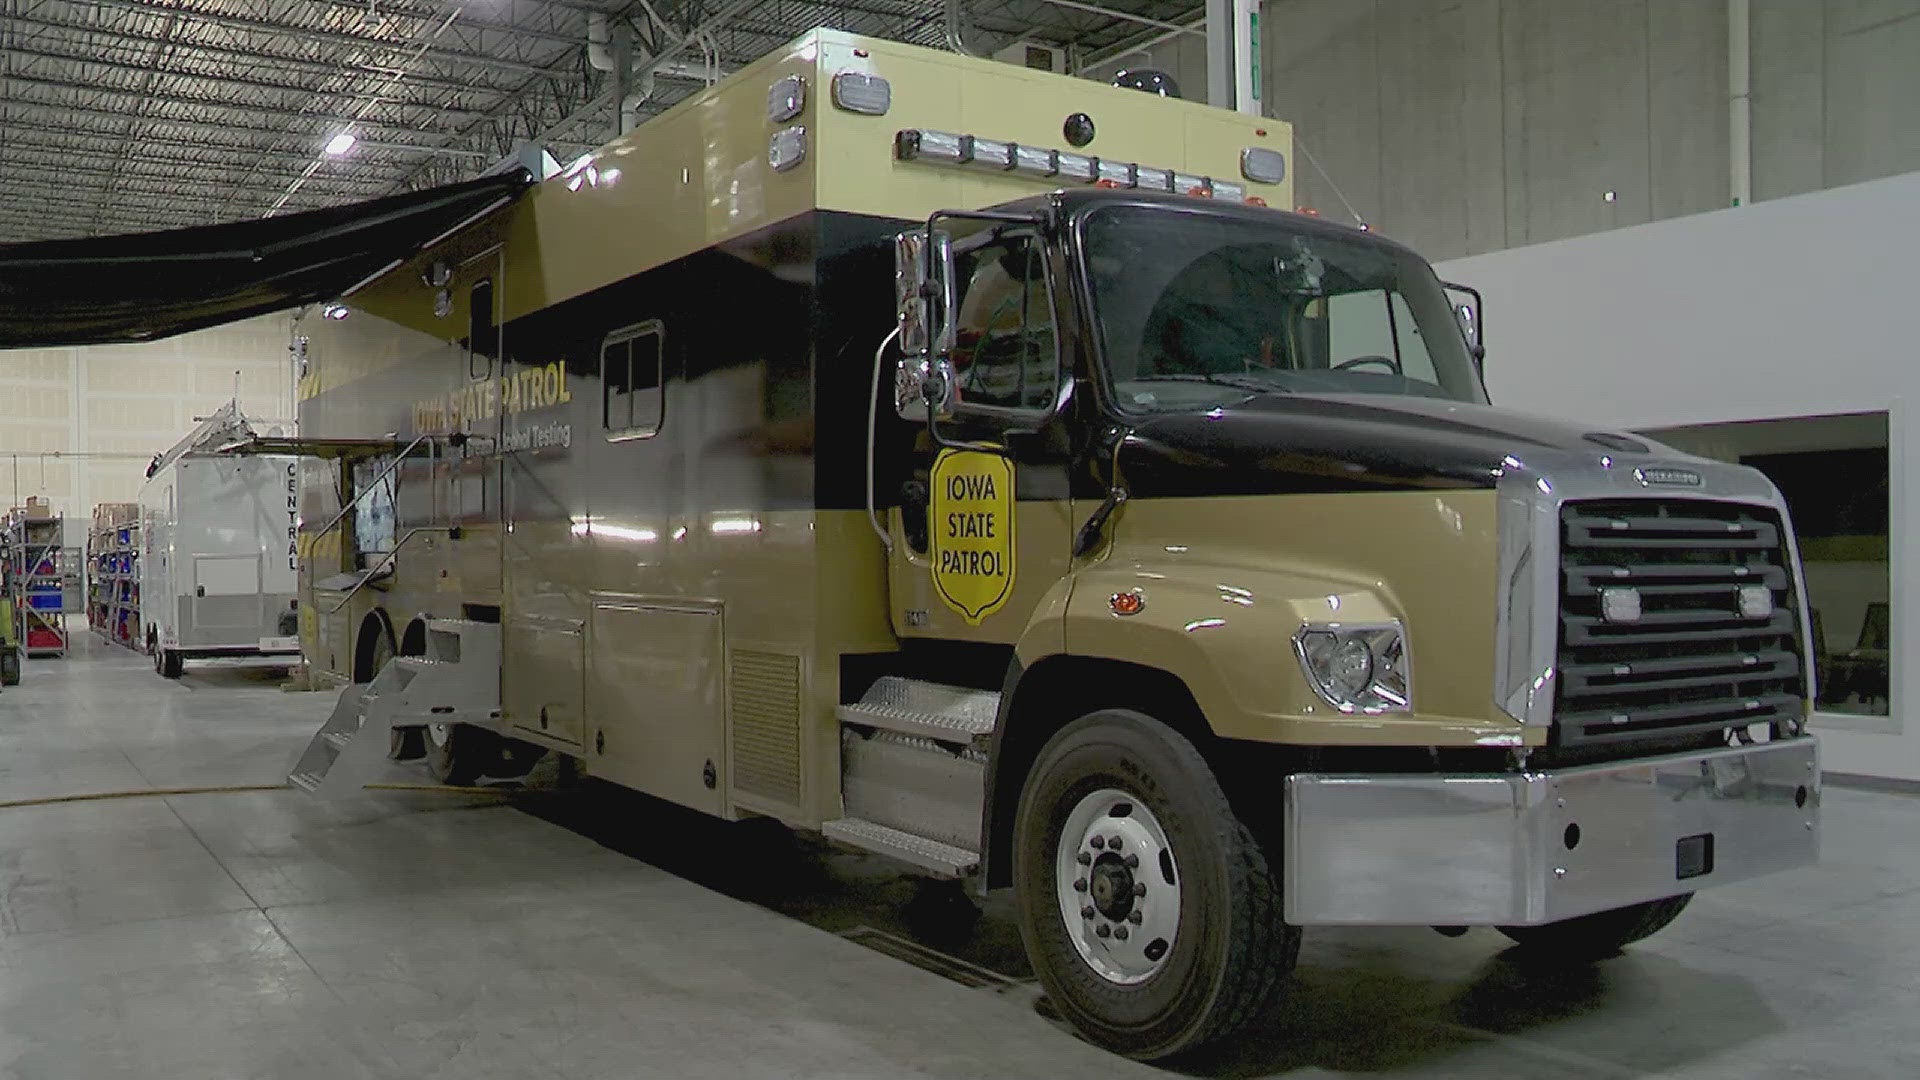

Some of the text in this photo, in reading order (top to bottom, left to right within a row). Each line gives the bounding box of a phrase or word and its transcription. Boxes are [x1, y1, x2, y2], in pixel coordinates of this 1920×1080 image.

[500, 359, 573, 415] PATROL
[532, 420, 572, 448] Testing
[946, 474, 996, 501] IOWA
[287, 463, 298, 570] CENTRAL
[948, 513, 995, 538] STATE
[941, 550, 1004, 577] PATROL
